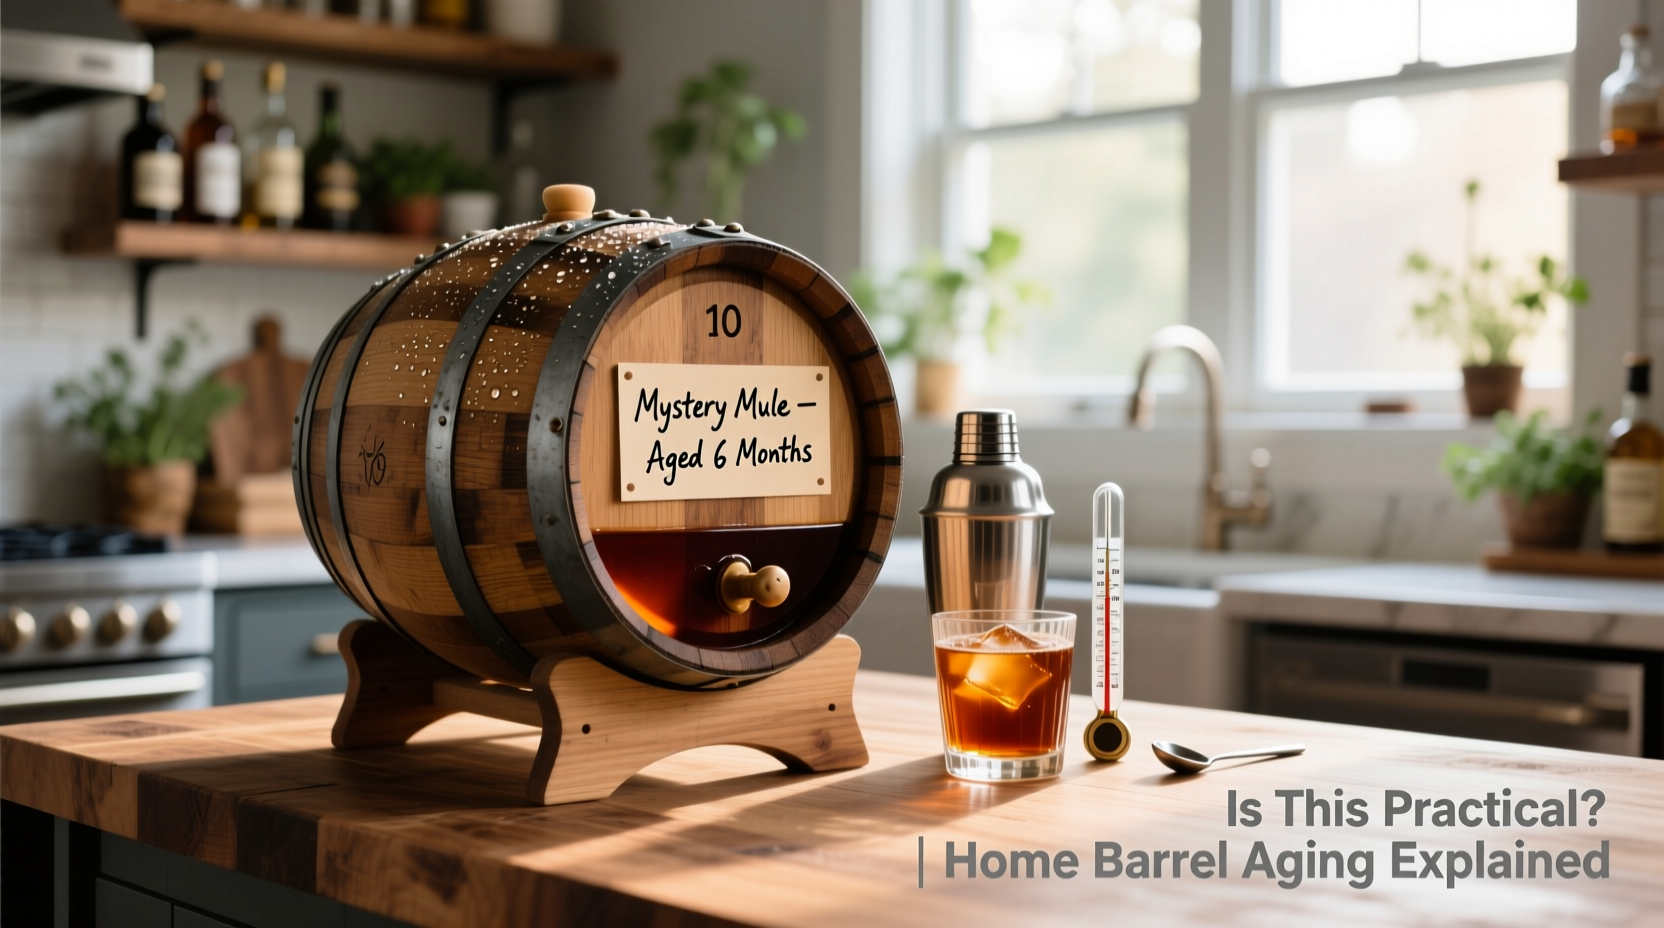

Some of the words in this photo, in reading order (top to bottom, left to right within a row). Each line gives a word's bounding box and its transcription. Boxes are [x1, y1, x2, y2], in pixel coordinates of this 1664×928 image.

[705, 303, 742, 338] 10
[634, 387, 728, 433] Mystery
[733, 387, 791, 419] Mule
[646, 438, 703, 486] Aged
[713, 439, 727, 469] 6
[735, 434, 812, 467] Months
